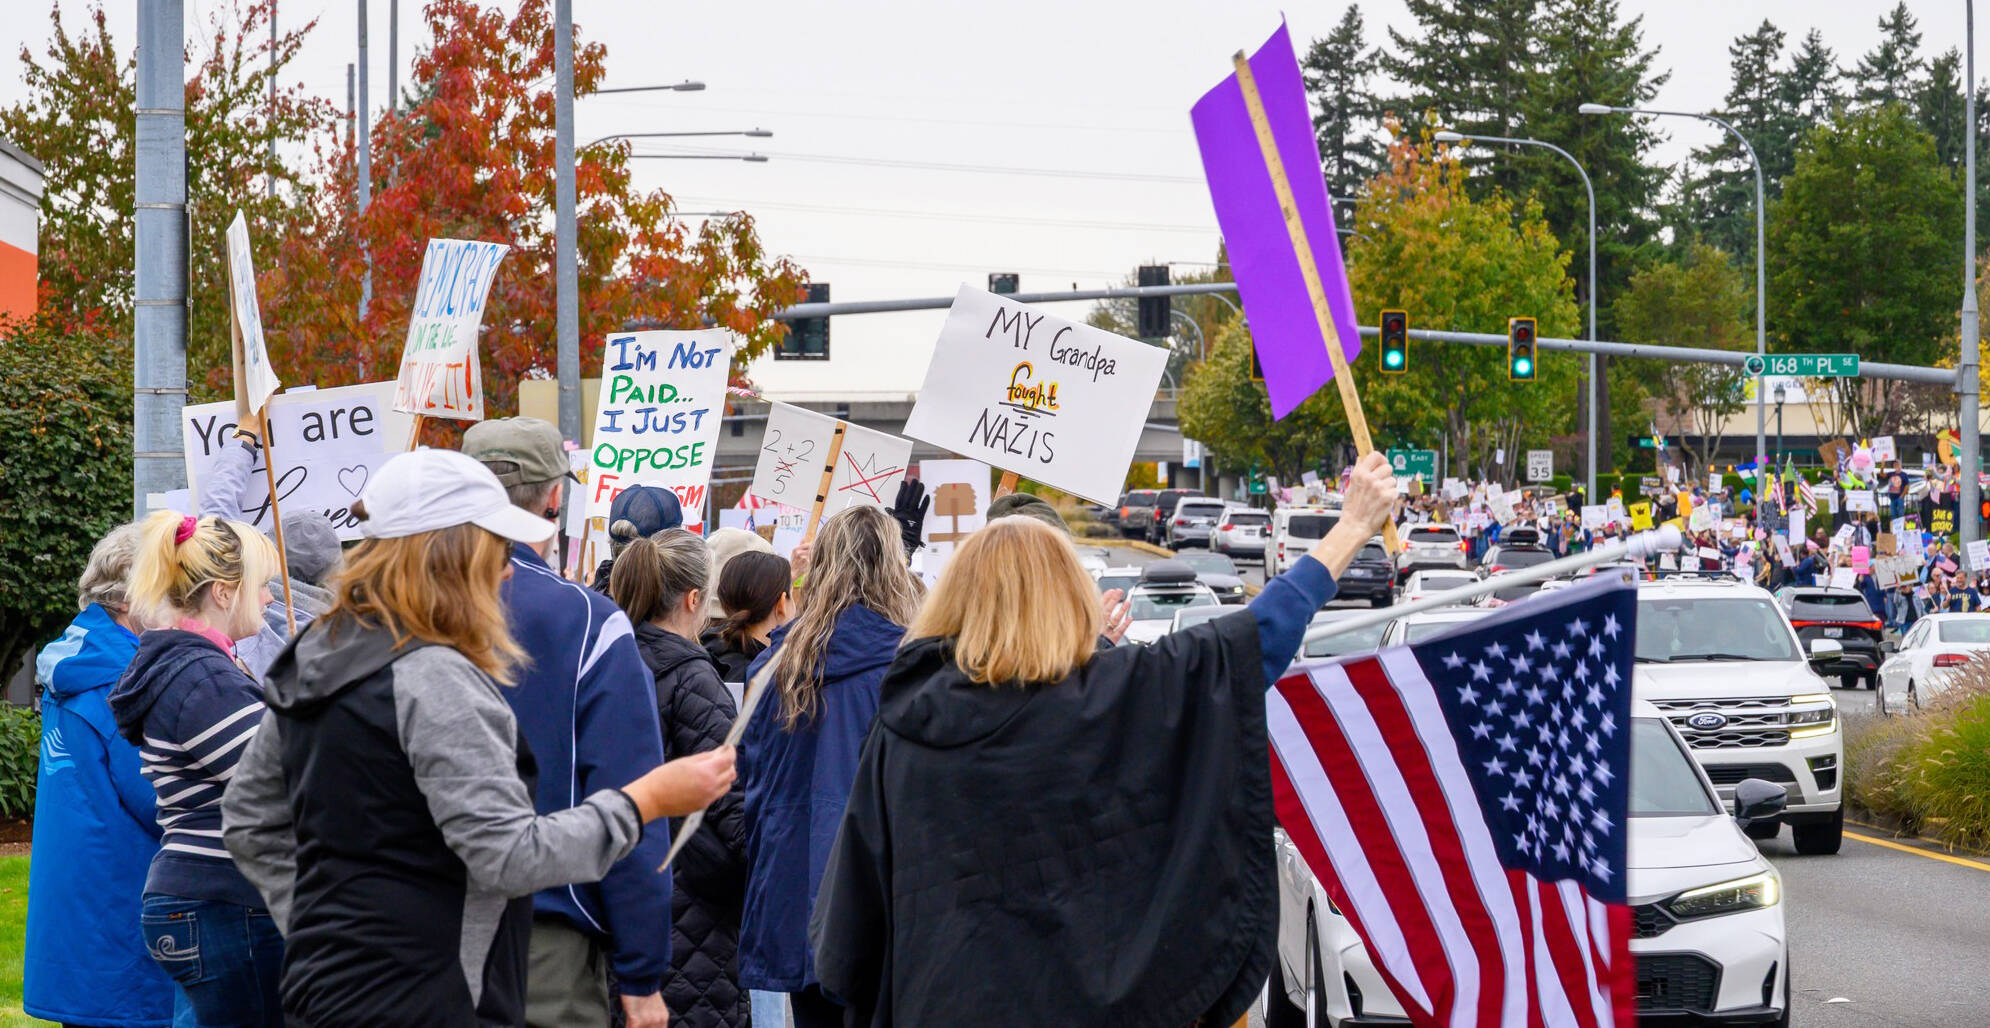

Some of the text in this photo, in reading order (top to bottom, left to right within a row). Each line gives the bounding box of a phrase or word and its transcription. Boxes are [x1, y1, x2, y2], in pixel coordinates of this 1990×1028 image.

[986, 307, 1115, 382] MY Grandpa
[1771, 357, 1853, 373] 168 TH PL SE
[1006, 362, 1059, 409] fought
[301, 405, 374, 443] are
[599, 407, 710, 434] I JUST
[968, 408, 1054, 463] NAZIS
[593, 442, 705, 474] OPPOSE
[1531, 467, 1550, 478] 35
[771, 475, 791, 495] 5
[1697, 716, 1717, 726] Ford
